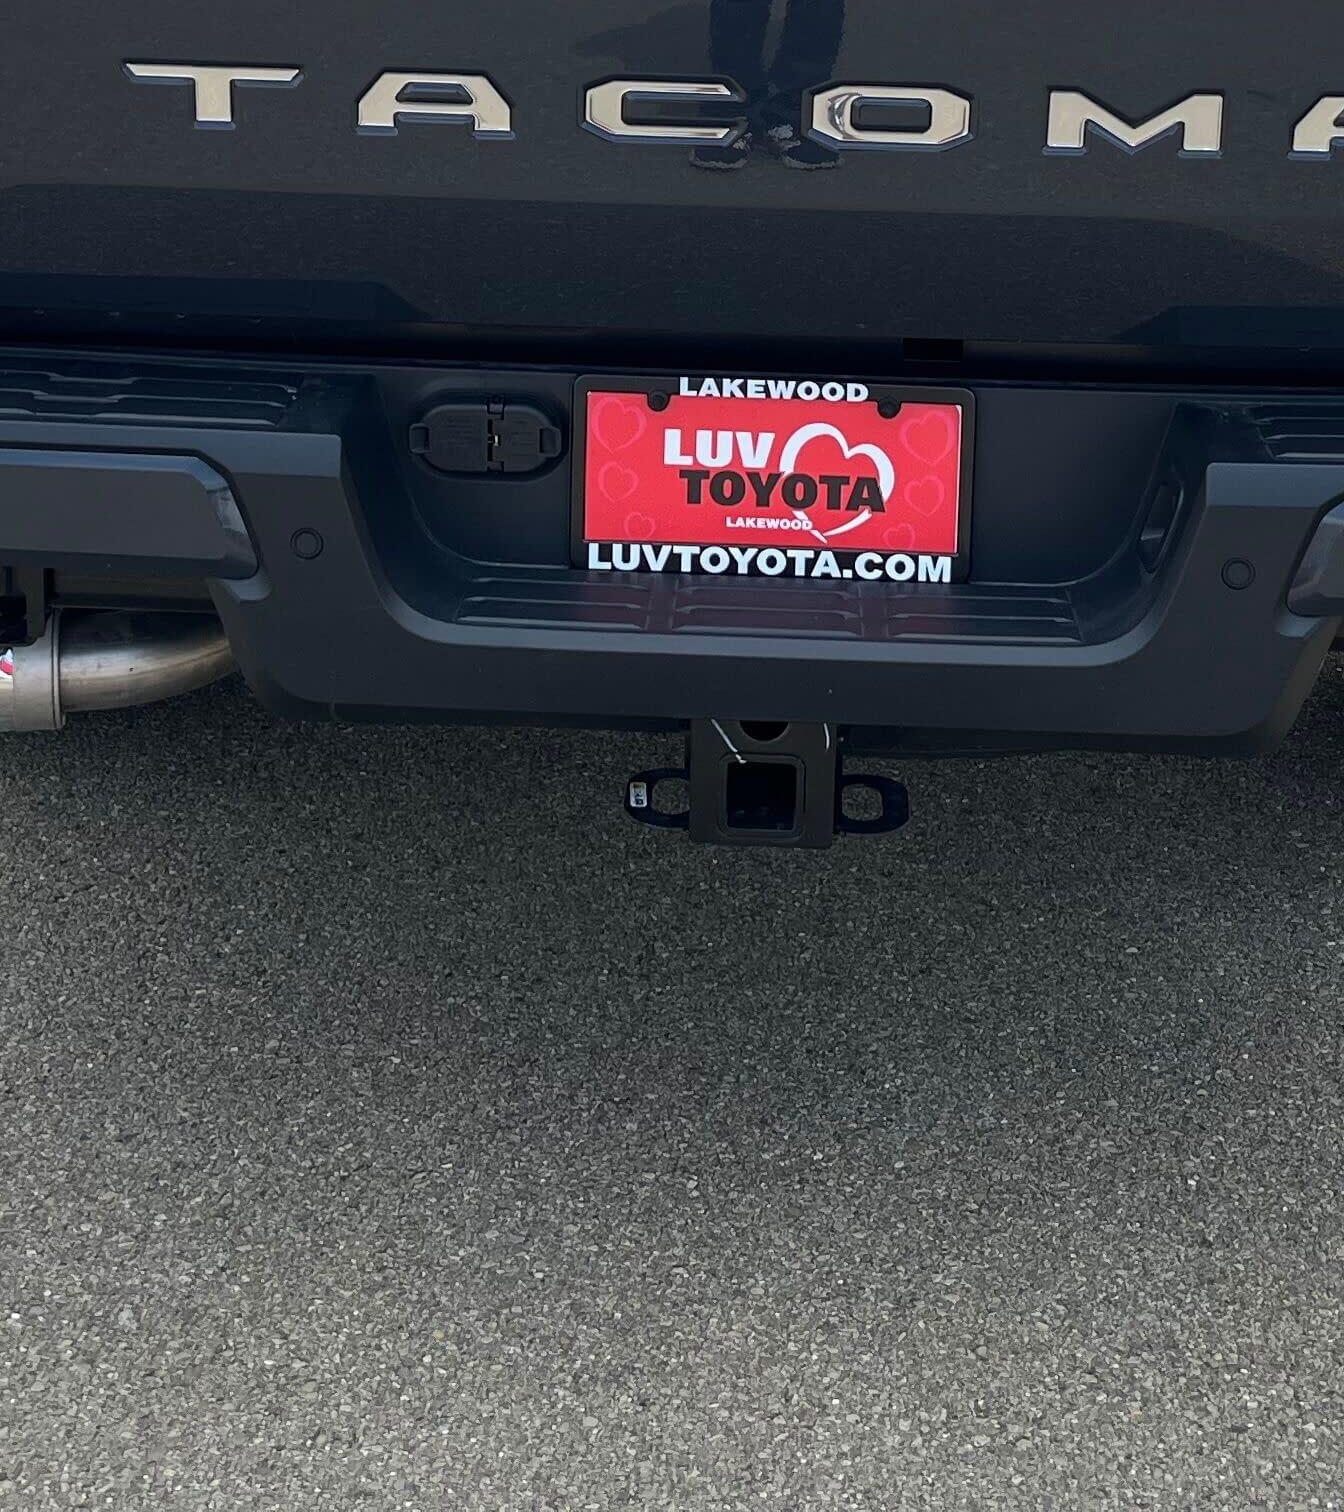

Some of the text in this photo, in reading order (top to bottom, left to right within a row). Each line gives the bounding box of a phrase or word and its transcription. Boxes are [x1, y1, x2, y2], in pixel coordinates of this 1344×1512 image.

[679, 376, 868, 402] LAKEWOOD
[663, 428, 776, 469] LUV
[679, 469, 886, 513] TOYOTA
[725, 515, 813, 531] LAKEWOOD
[587, 541, 952, 584] LUVTOYOTA.COM
